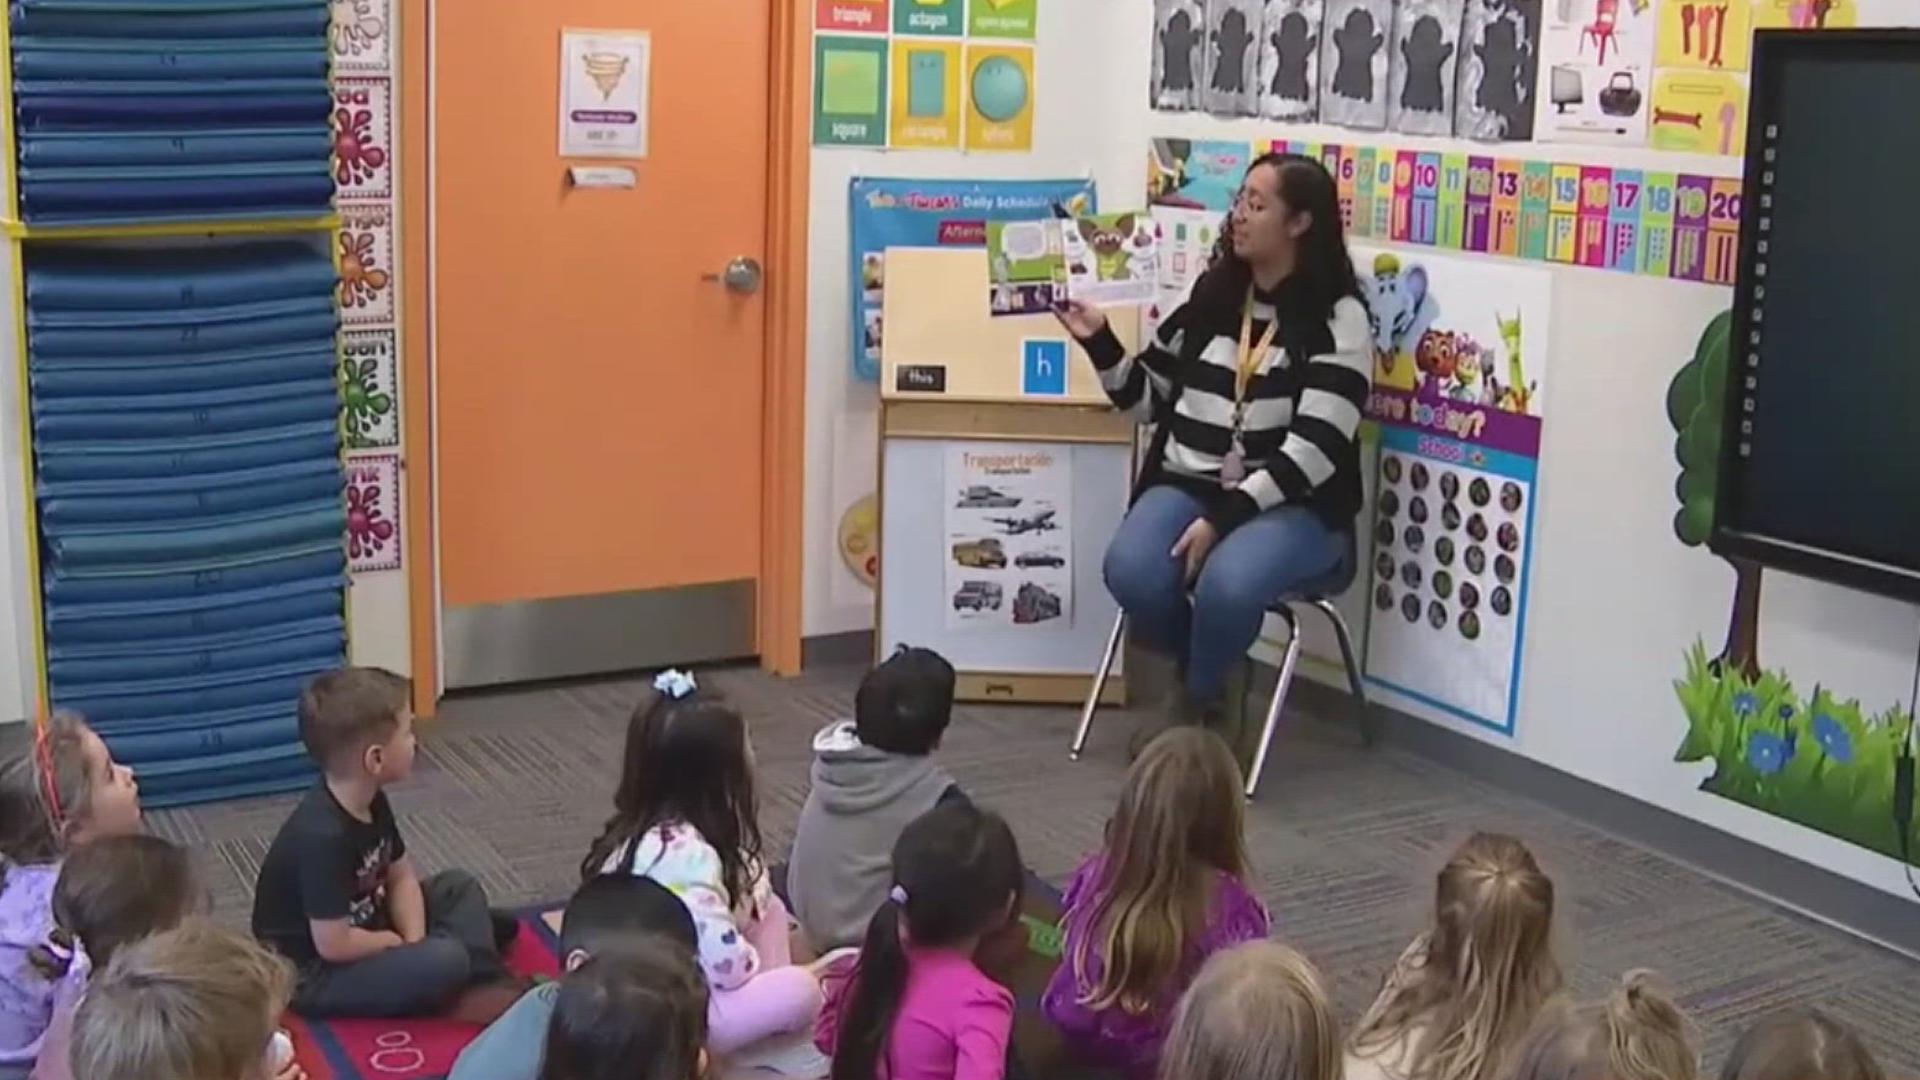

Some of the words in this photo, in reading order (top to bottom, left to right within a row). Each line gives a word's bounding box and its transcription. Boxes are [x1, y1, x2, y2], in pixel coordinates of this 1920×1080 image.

[833, 6, 872, 25] triangle
[908, 12, 948, 30] octagon
[336, 88, 369, 105] ed
[832, 122, 867, 140] square
[1341, 158, 1353, 179] 6
[1416, 164, 1436, 187] 10
[1445, 167, 1460, 190] 11
[1498, 171, 1518, 196] 13
[1554, 176, 1576, 202] 15
[1615, 182, 1639, 208] 17
[1647, 186, 1672, 214] 18
[1711, 191, 1742, 220] 20
[962, 196, 993, 211] Daily
[943, 225, 985, 238] Aftern
[1037, 346, 1052, 376] h
[909, 369, 935, 385] this
[1410, 397, 1486, 439] today?
